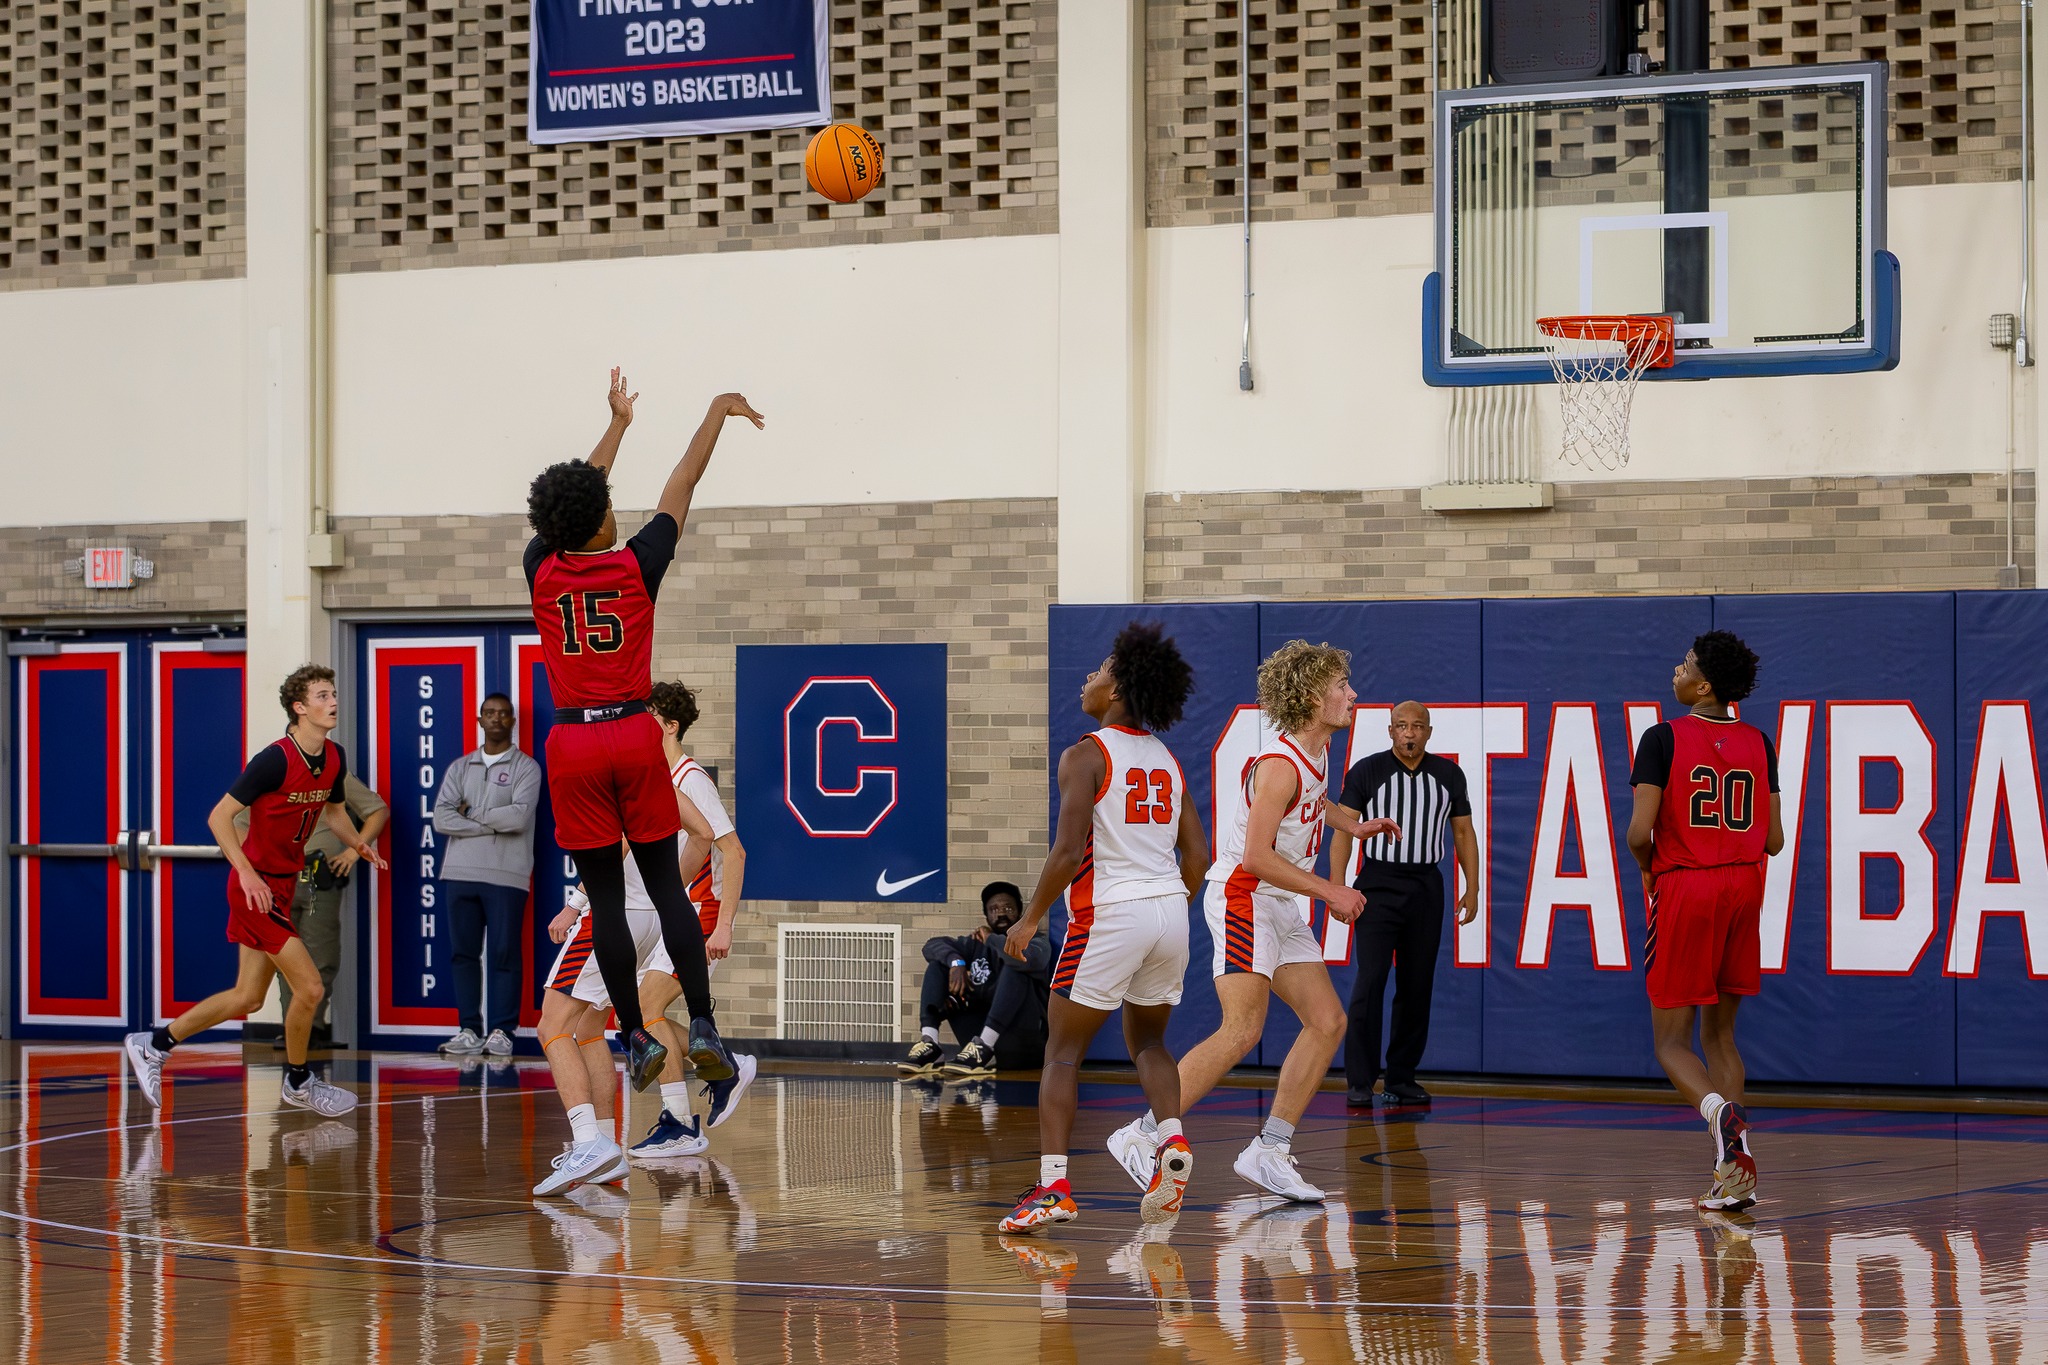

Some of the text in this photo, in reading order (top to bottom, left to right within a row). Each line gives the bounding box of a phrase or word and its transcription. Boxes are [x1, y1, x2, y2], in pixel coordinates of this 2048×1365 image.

[625, 17, 706, 56] 2023
[546, 70, 802, 112] WOMEN'S BASKETBALL
[849, 145, 867, 181] NCAA
[92, 549, 124, 582] EXIT
[556, 590, 624, 655] 15
[784, 676, 898, 838] C
[1125, 767, 1173, 824] 23
[1690, 765, 1755, 832] 20
[418, 675, 436, 998] SCHOLARSHIP
